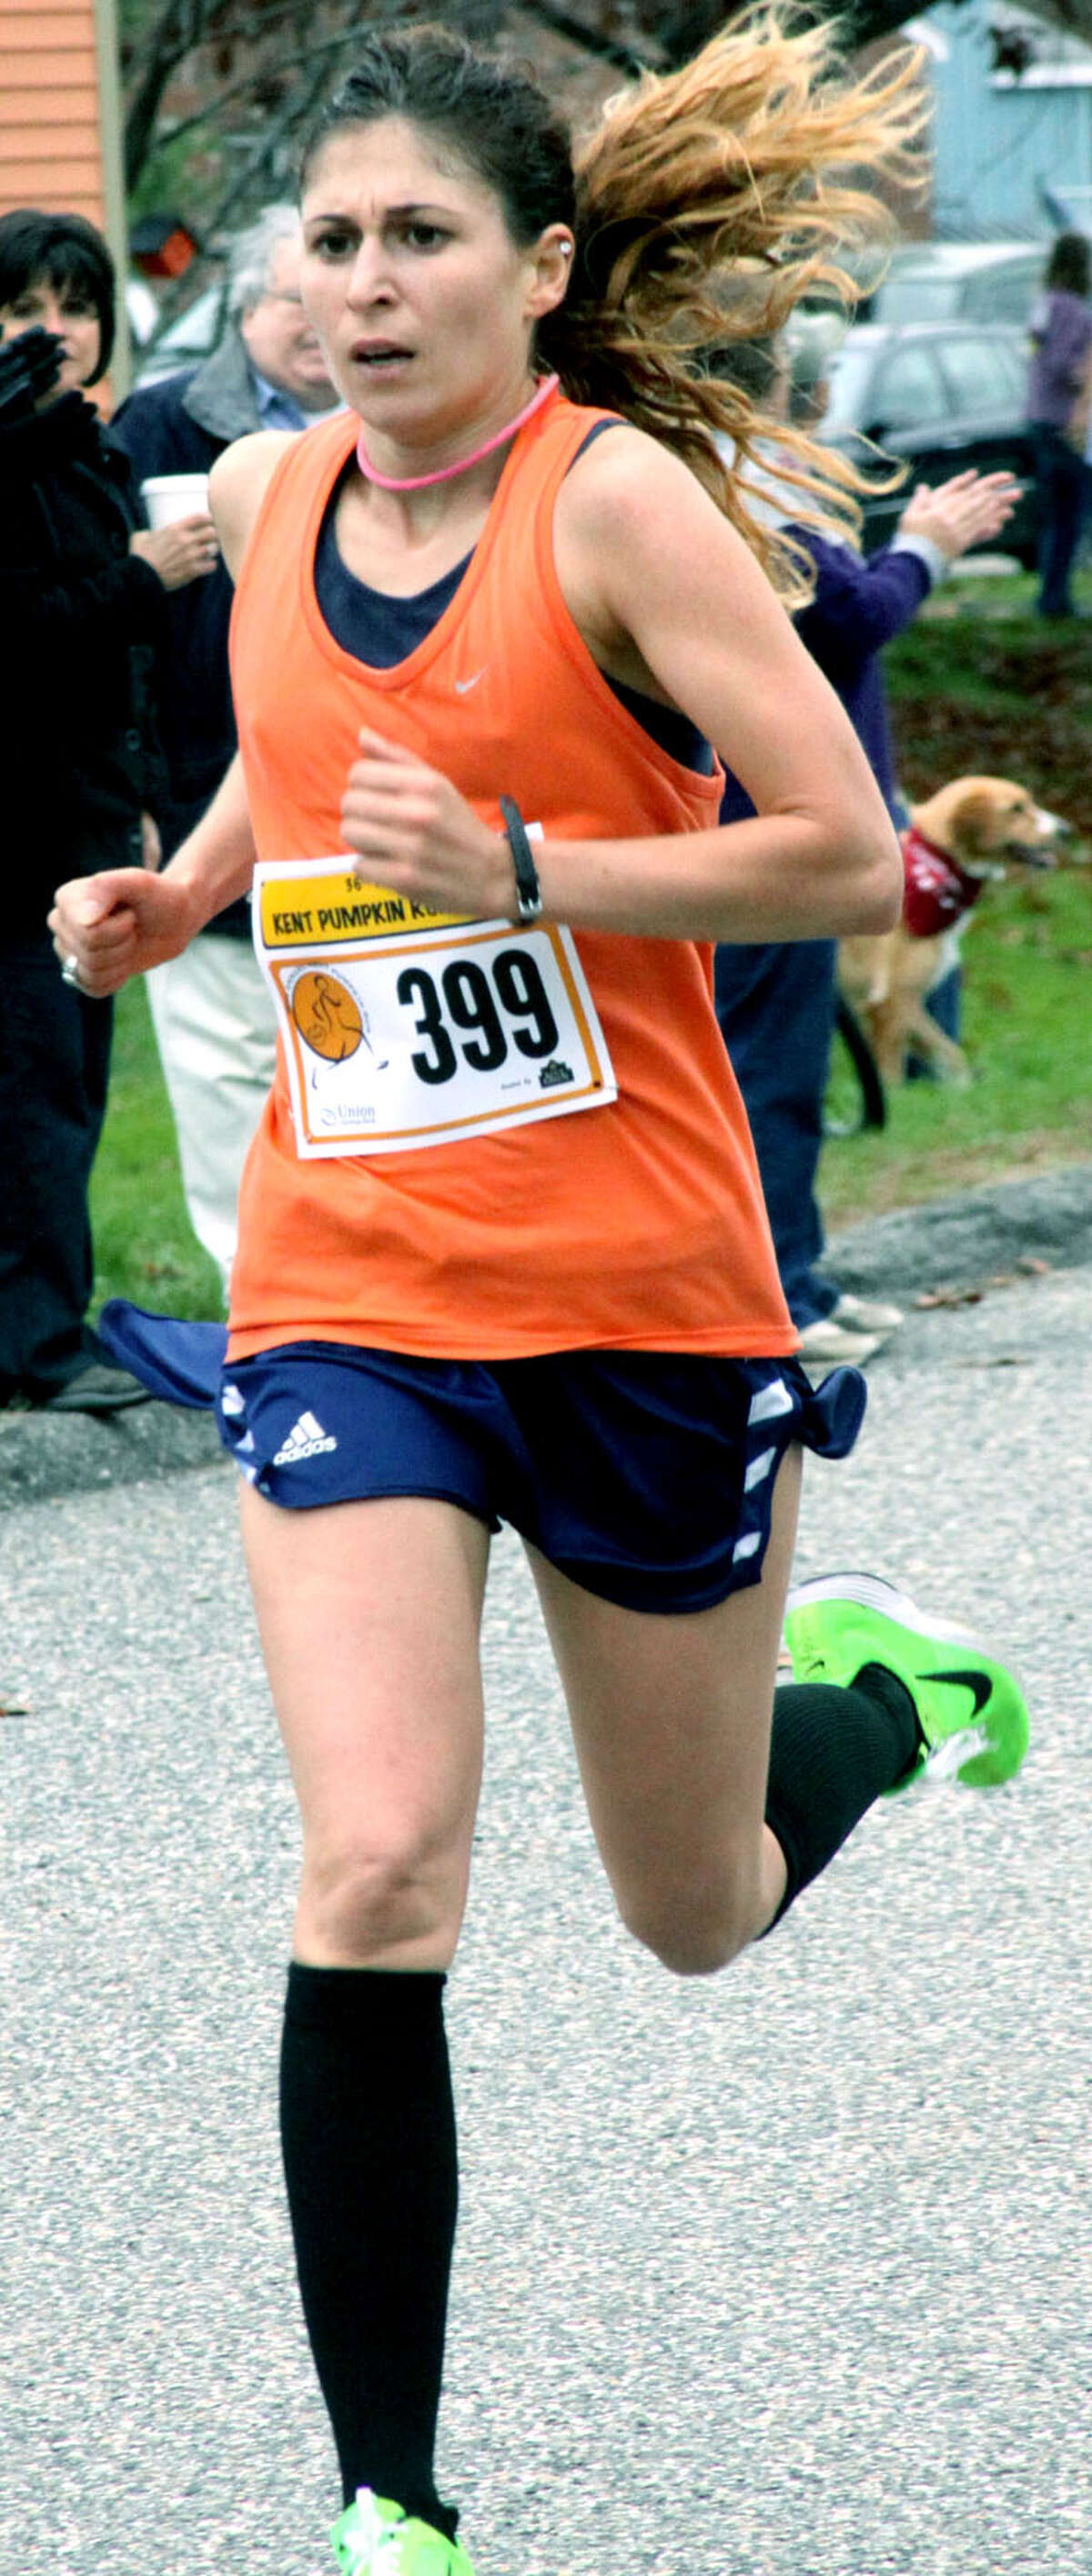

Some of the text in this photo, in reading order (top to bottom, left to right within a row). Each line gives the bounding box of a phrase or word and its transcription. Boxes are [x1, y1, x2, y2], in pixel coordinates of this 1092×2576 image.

[273, 911, 314, 936] KENT
[318, 899, 406, 931] PUMPKIN
[397, 949, 560, 1086] 399
[338, 1103, 376, 1118] Union
[273, 1436, 337, 1466] adidas
